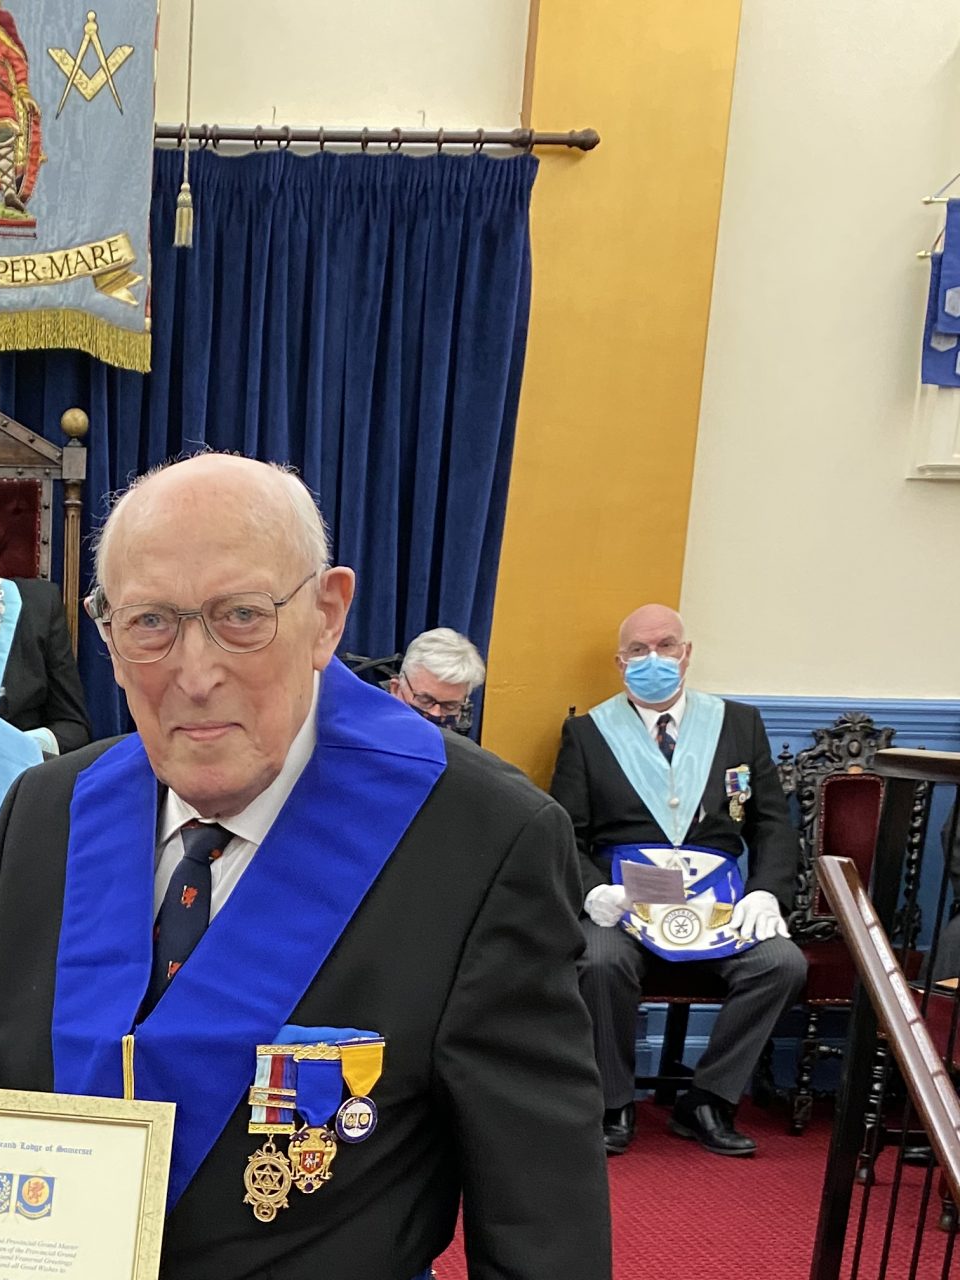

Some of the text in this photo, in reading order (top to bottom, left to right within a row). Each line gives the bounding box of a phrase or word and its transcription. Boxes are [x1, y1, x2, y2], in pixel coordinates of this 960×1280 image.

[20, 1141, 42, 1152] Lodge
[45, 1144, 53, 1152] of
[56, 1145, 93, 1156] Somerset
[38, 1240, 57, 1248] Grand
